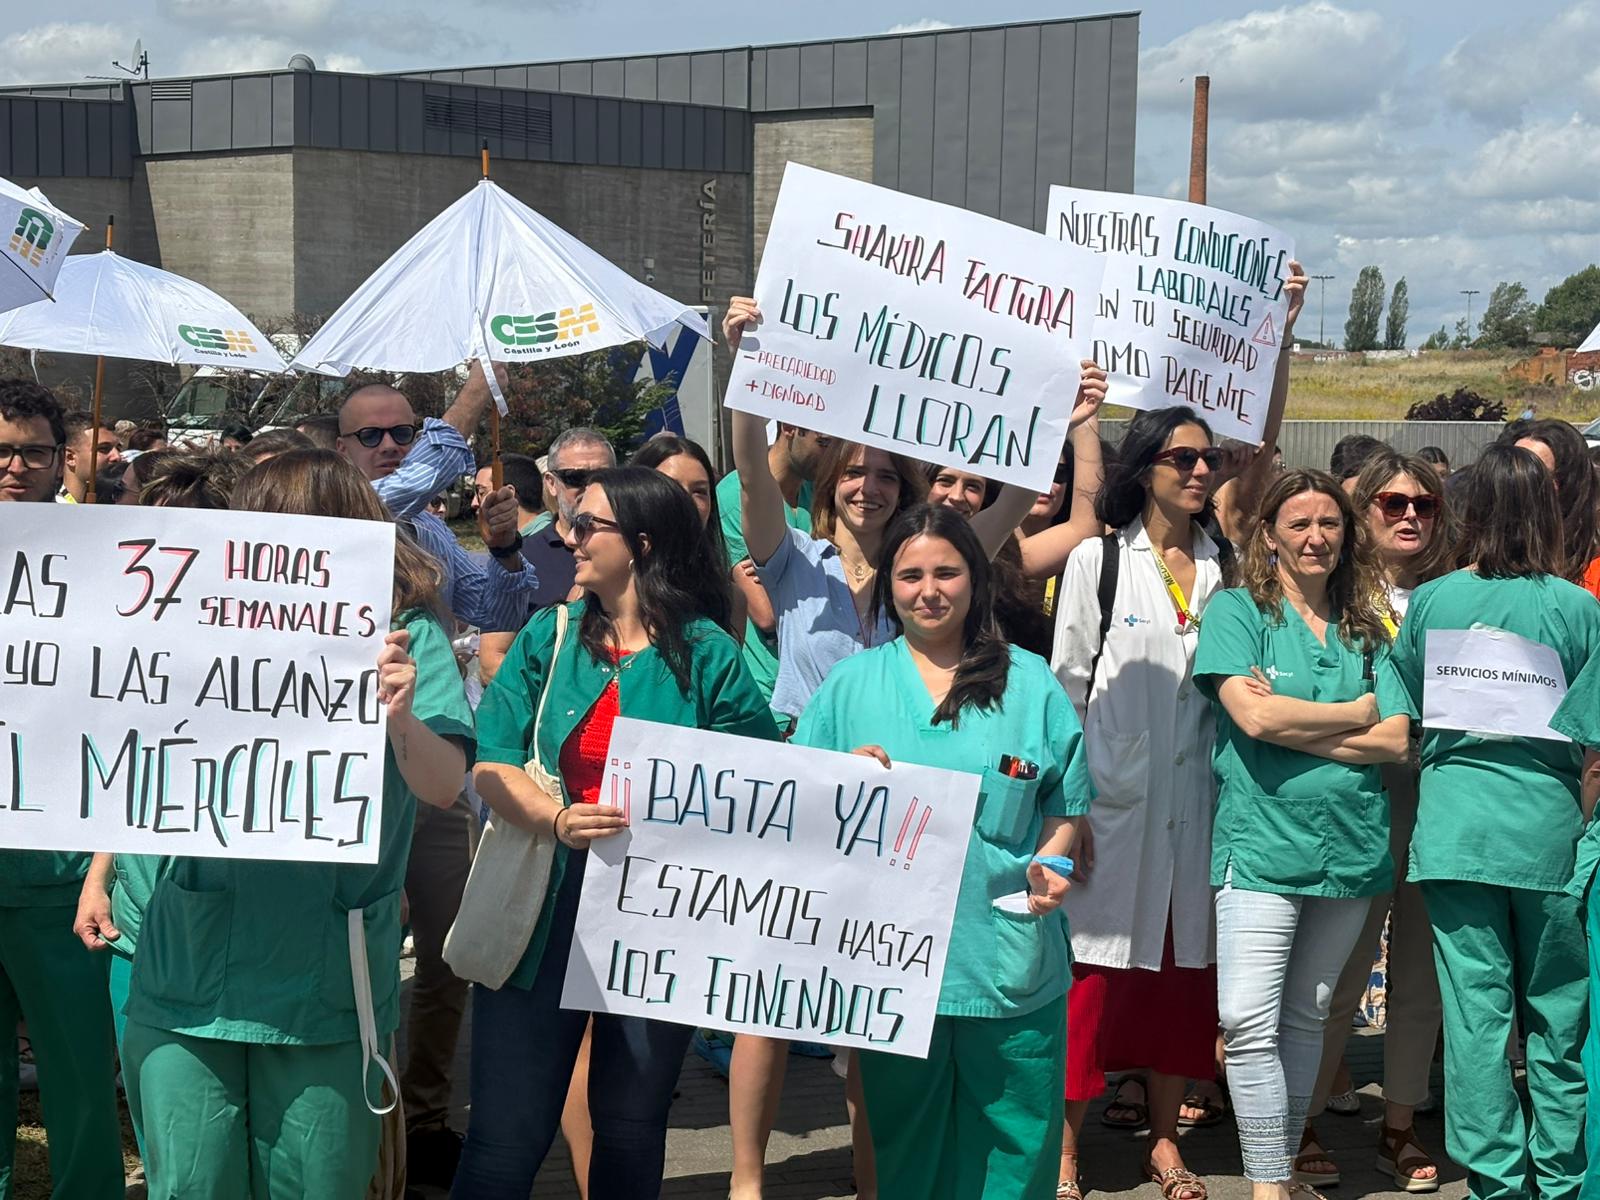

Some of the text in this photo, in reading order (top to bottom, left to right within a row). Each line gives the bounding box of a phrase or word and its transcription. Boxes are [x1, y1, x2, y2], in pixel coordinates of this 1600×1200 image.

[817, 212, 1075, 339] SHAKIRA FACTURA
[1059, 200, 1287, 301] NUESTRAS CONDICIONES
[490, 303, 600, 346] CESM
[1136, 265, 1252, 327] LABORALES
[177, 324, 258, 353] CESM
[194, 348, 223, 357] Castilla
[503, 346, 543, 355] Castilla
[554, 340, 581, 350] León
[758, 350, 837, 386] PRECARIEDAD
[779, 278, 1011, 397] LOS MÉDICOS
[1092, 340, 1151, 379] OMO
[1131, 300, 1155, 328] TU
[1167, 308, 1259, 373] SEGURIDAD
[761, 380, 826, 412] DIGNIDAD
[862, 384, 1041, 467] LLORAN
[1160, 355, 1257, 426] PACIENTE
[0, 538, 331, 622] AS 37 HORAS
[198, 596, 377, 638] SEMANALES
[90, 646, 171, 705] LAS
[195, 655, 380, 725] ALCANZO
[1436, 665, 1558, 688] SERVICIOS MÍNIMOS
[0, 719, 374, 850] L MIÉRCOLES
[616, 855, 935, 978] ESTAMOS HASTA
[606, 939, 904, 1045] LOS FONENDOS
